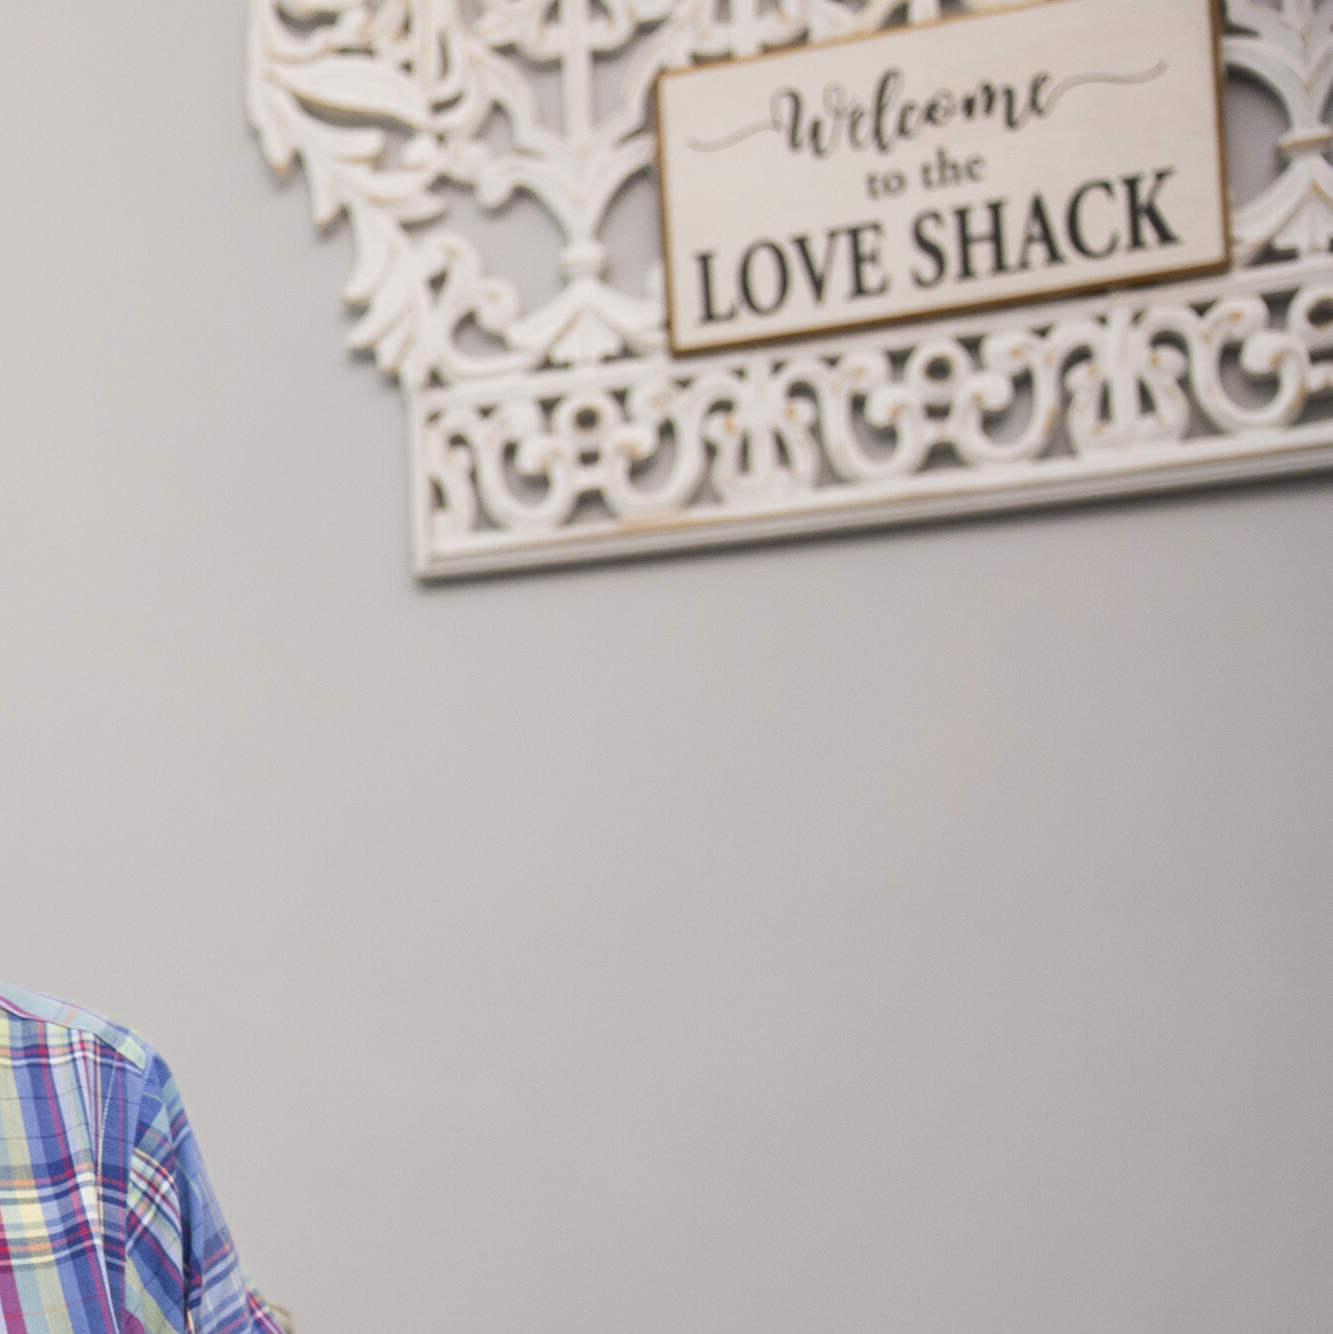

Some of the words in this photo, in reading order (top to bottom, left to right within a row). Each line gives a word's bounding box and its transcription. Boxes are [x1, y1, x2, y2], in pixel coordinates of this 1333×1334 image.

[770, 66, 1055, 158] Welcome
[865, 169, 907, 200] to
[918, 147, 987, 192] the
[694, 222, 891, 325] LOVE
[908, 167, 1183, 290] SHACK
